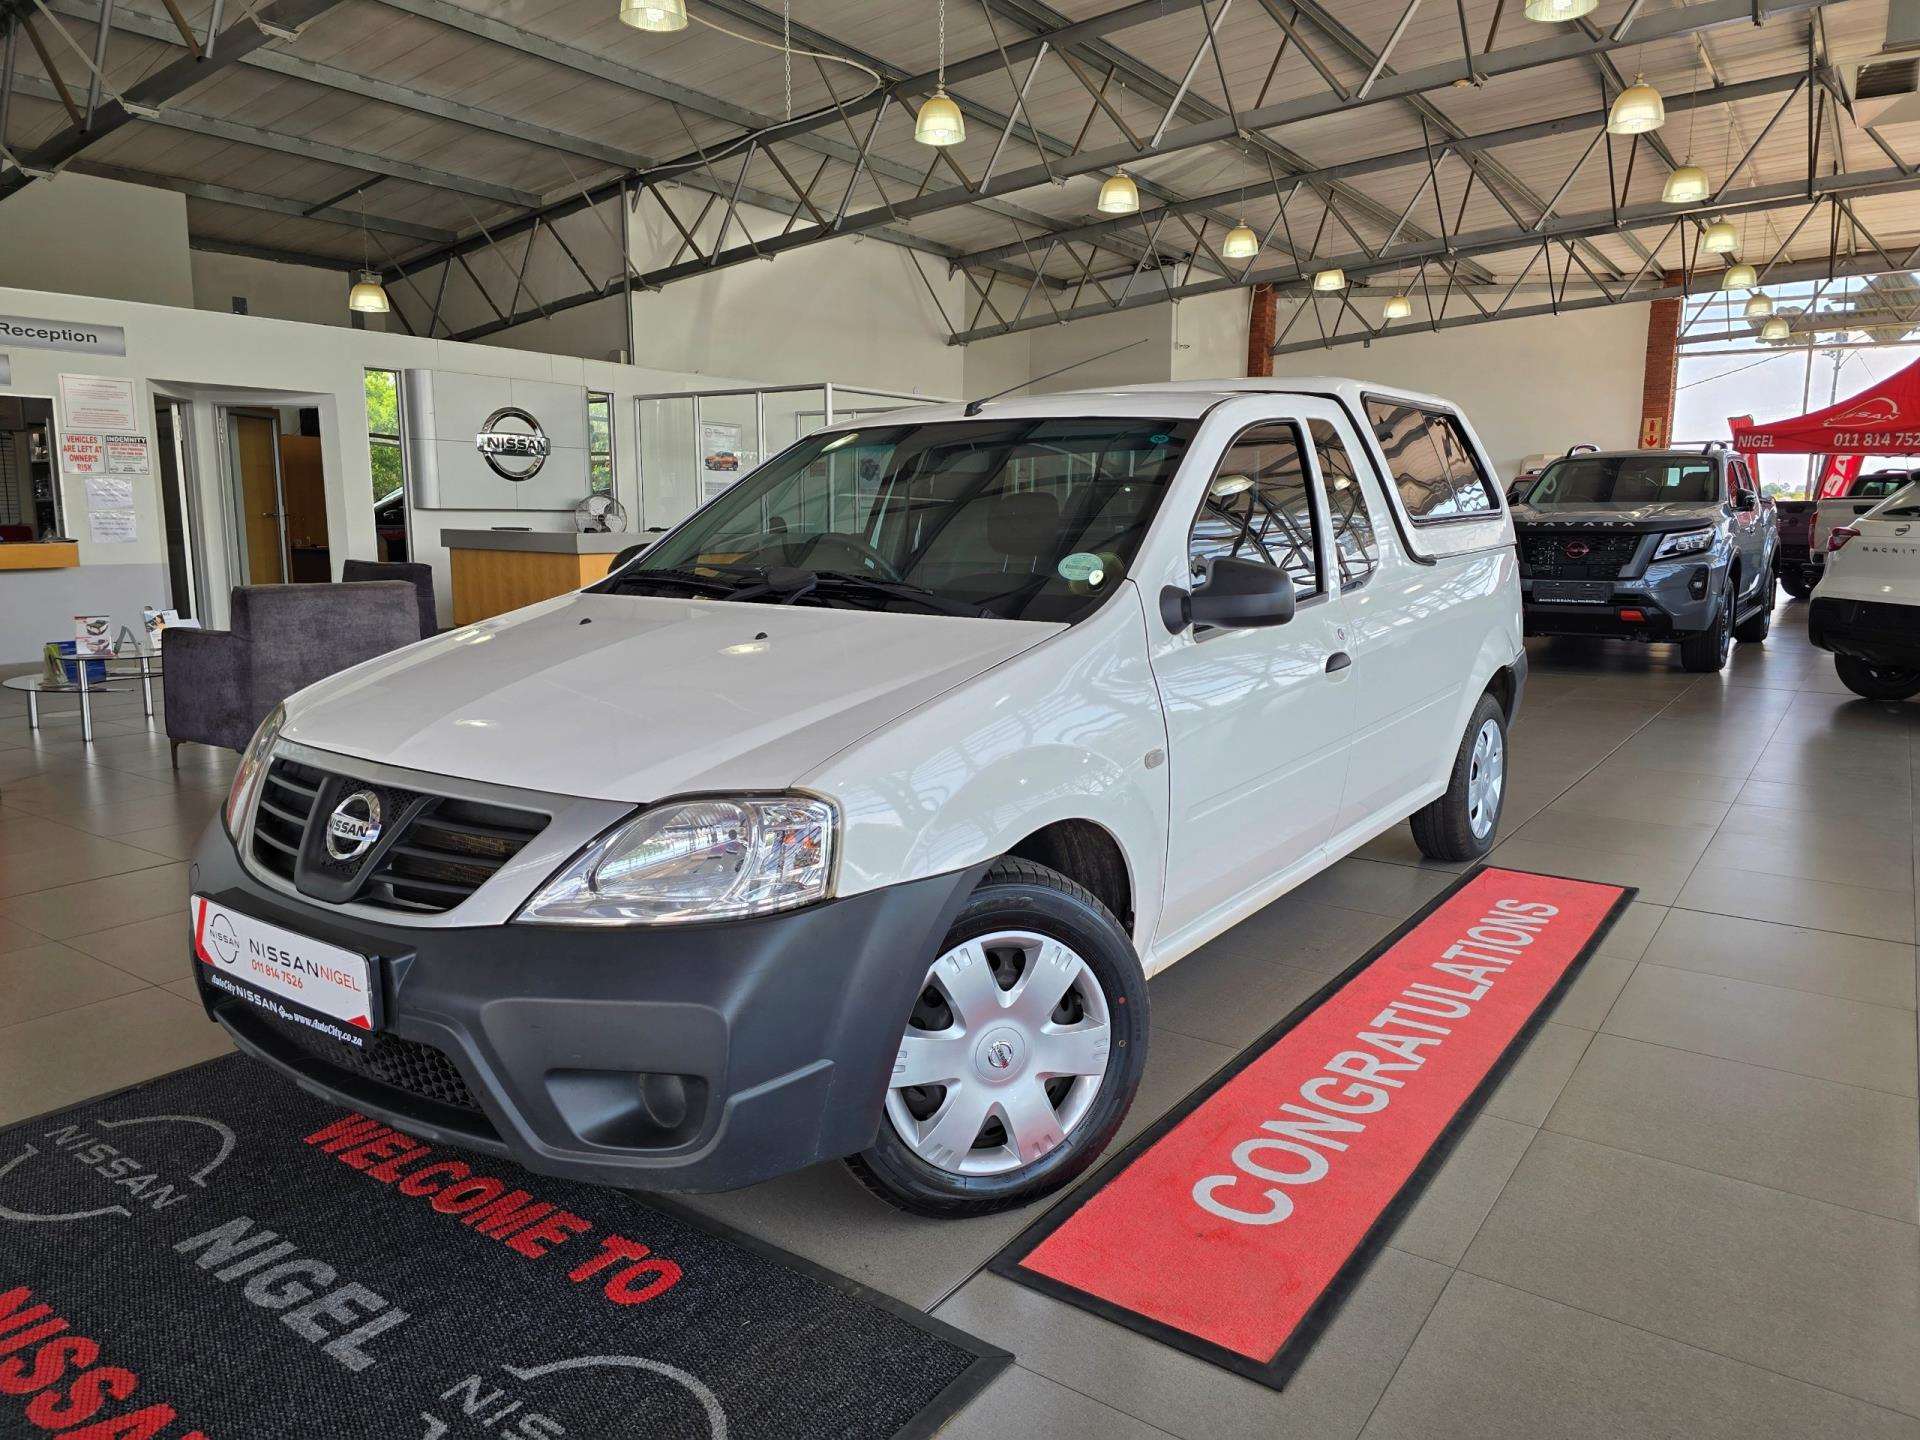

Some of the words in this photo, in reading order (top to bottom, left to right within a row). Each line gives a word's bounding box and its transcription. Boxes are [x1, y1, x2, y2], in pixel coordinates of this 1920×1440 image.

[0, 322, 98, 343] Reception
[66, 434, 97, 444] VEHICLES
[106, 435, 147, 443] INDEMNITY
[486, 436, 545, 451] NISSAN
[1738, 435, 1775, 448] NIGEL
[1833, 432, 1859, 446] 011
[1863, 432, 1890, 446] 814
[69, 454, 98, 462] OWNER'S
[77, 445, 92, 453] LEFT
[76, 463, 93, 472] RISK
[330, 818, 369, 838] NISSAN
[209, 929, 240, 948] NISSAN
[252, 959, 265, 973] 011
[266, 965, 280, 980] 814
[281, 971, 304, 989] 7526
[236, 984, 278, 1013] NISSAN
[1192, 899, 1560, 1226] CONGRATULATIONS
[44, 1124, 190, 1212] NISSAN
[303, 1110, 593, 1259] WELCOME
[568, 1232, 685, 1305] TO
[172, 1215, 412, 1373] NIGEL
[0, 1286, 211, 1440] NISSA
